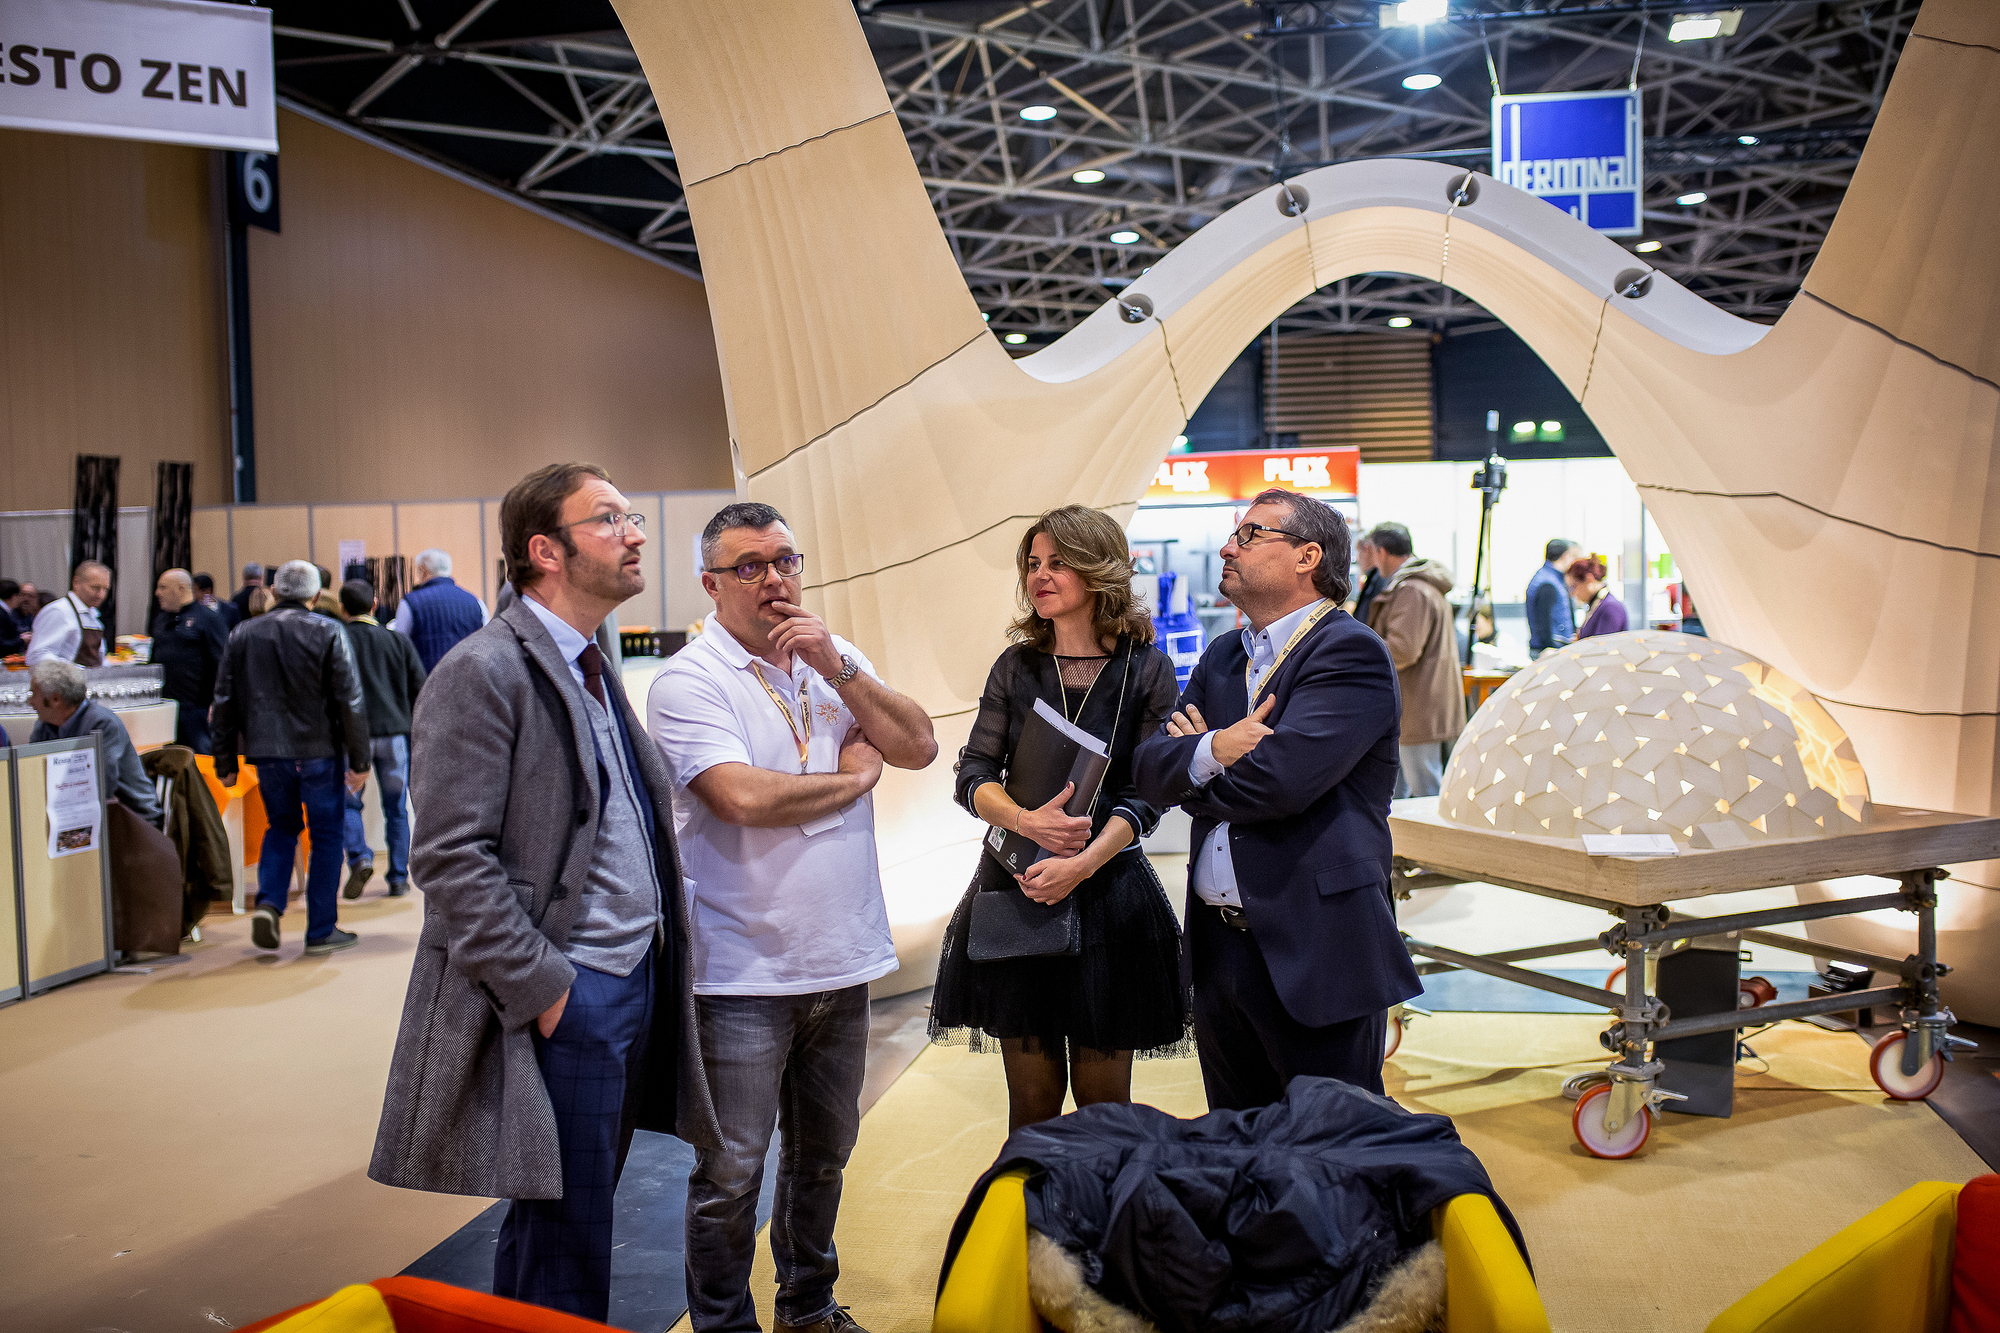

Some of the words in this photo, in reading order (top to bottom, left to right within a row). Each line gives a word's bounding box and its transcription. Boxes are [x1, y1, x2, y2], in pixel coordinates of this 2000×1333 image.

[0, 43, 122, 94] STO
[140, 58, 247, 108] ZEN
[243, 152, 273, 213] 6
[1263, 456, 1330, 486] FLEX
